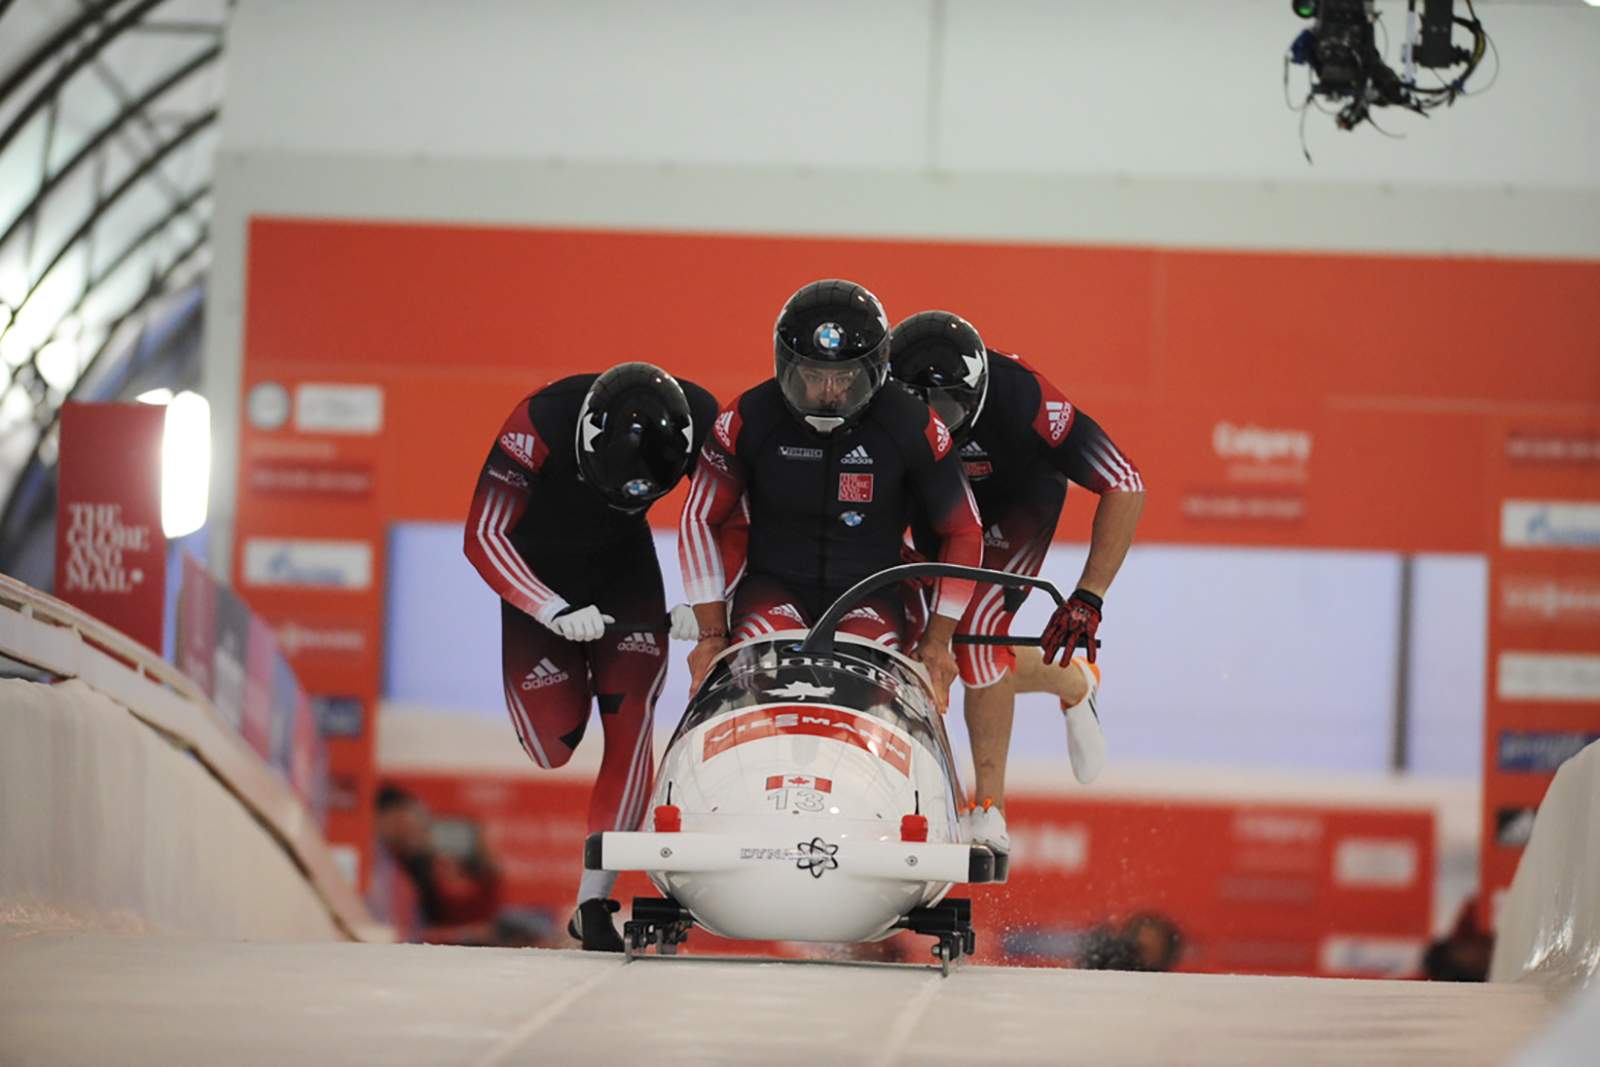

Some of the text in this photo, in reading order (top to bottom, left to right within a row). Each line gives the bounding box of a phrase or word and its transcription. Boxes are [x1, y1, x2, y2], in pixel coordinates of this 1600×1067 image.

[1052, 401, 1073, 440] adidas
[501, 435, 534, 469] adidas
[840, 457, 874, 465] adidas
[68, 503, 122, 530] THE
[66, 526, 150, 552] GLOBE
[69, 546, 123, 571] AND
[617, 641, 660, 656] adidas
[521, 671, 569, 691] adidas
[766, 789, 825, 812] 13
